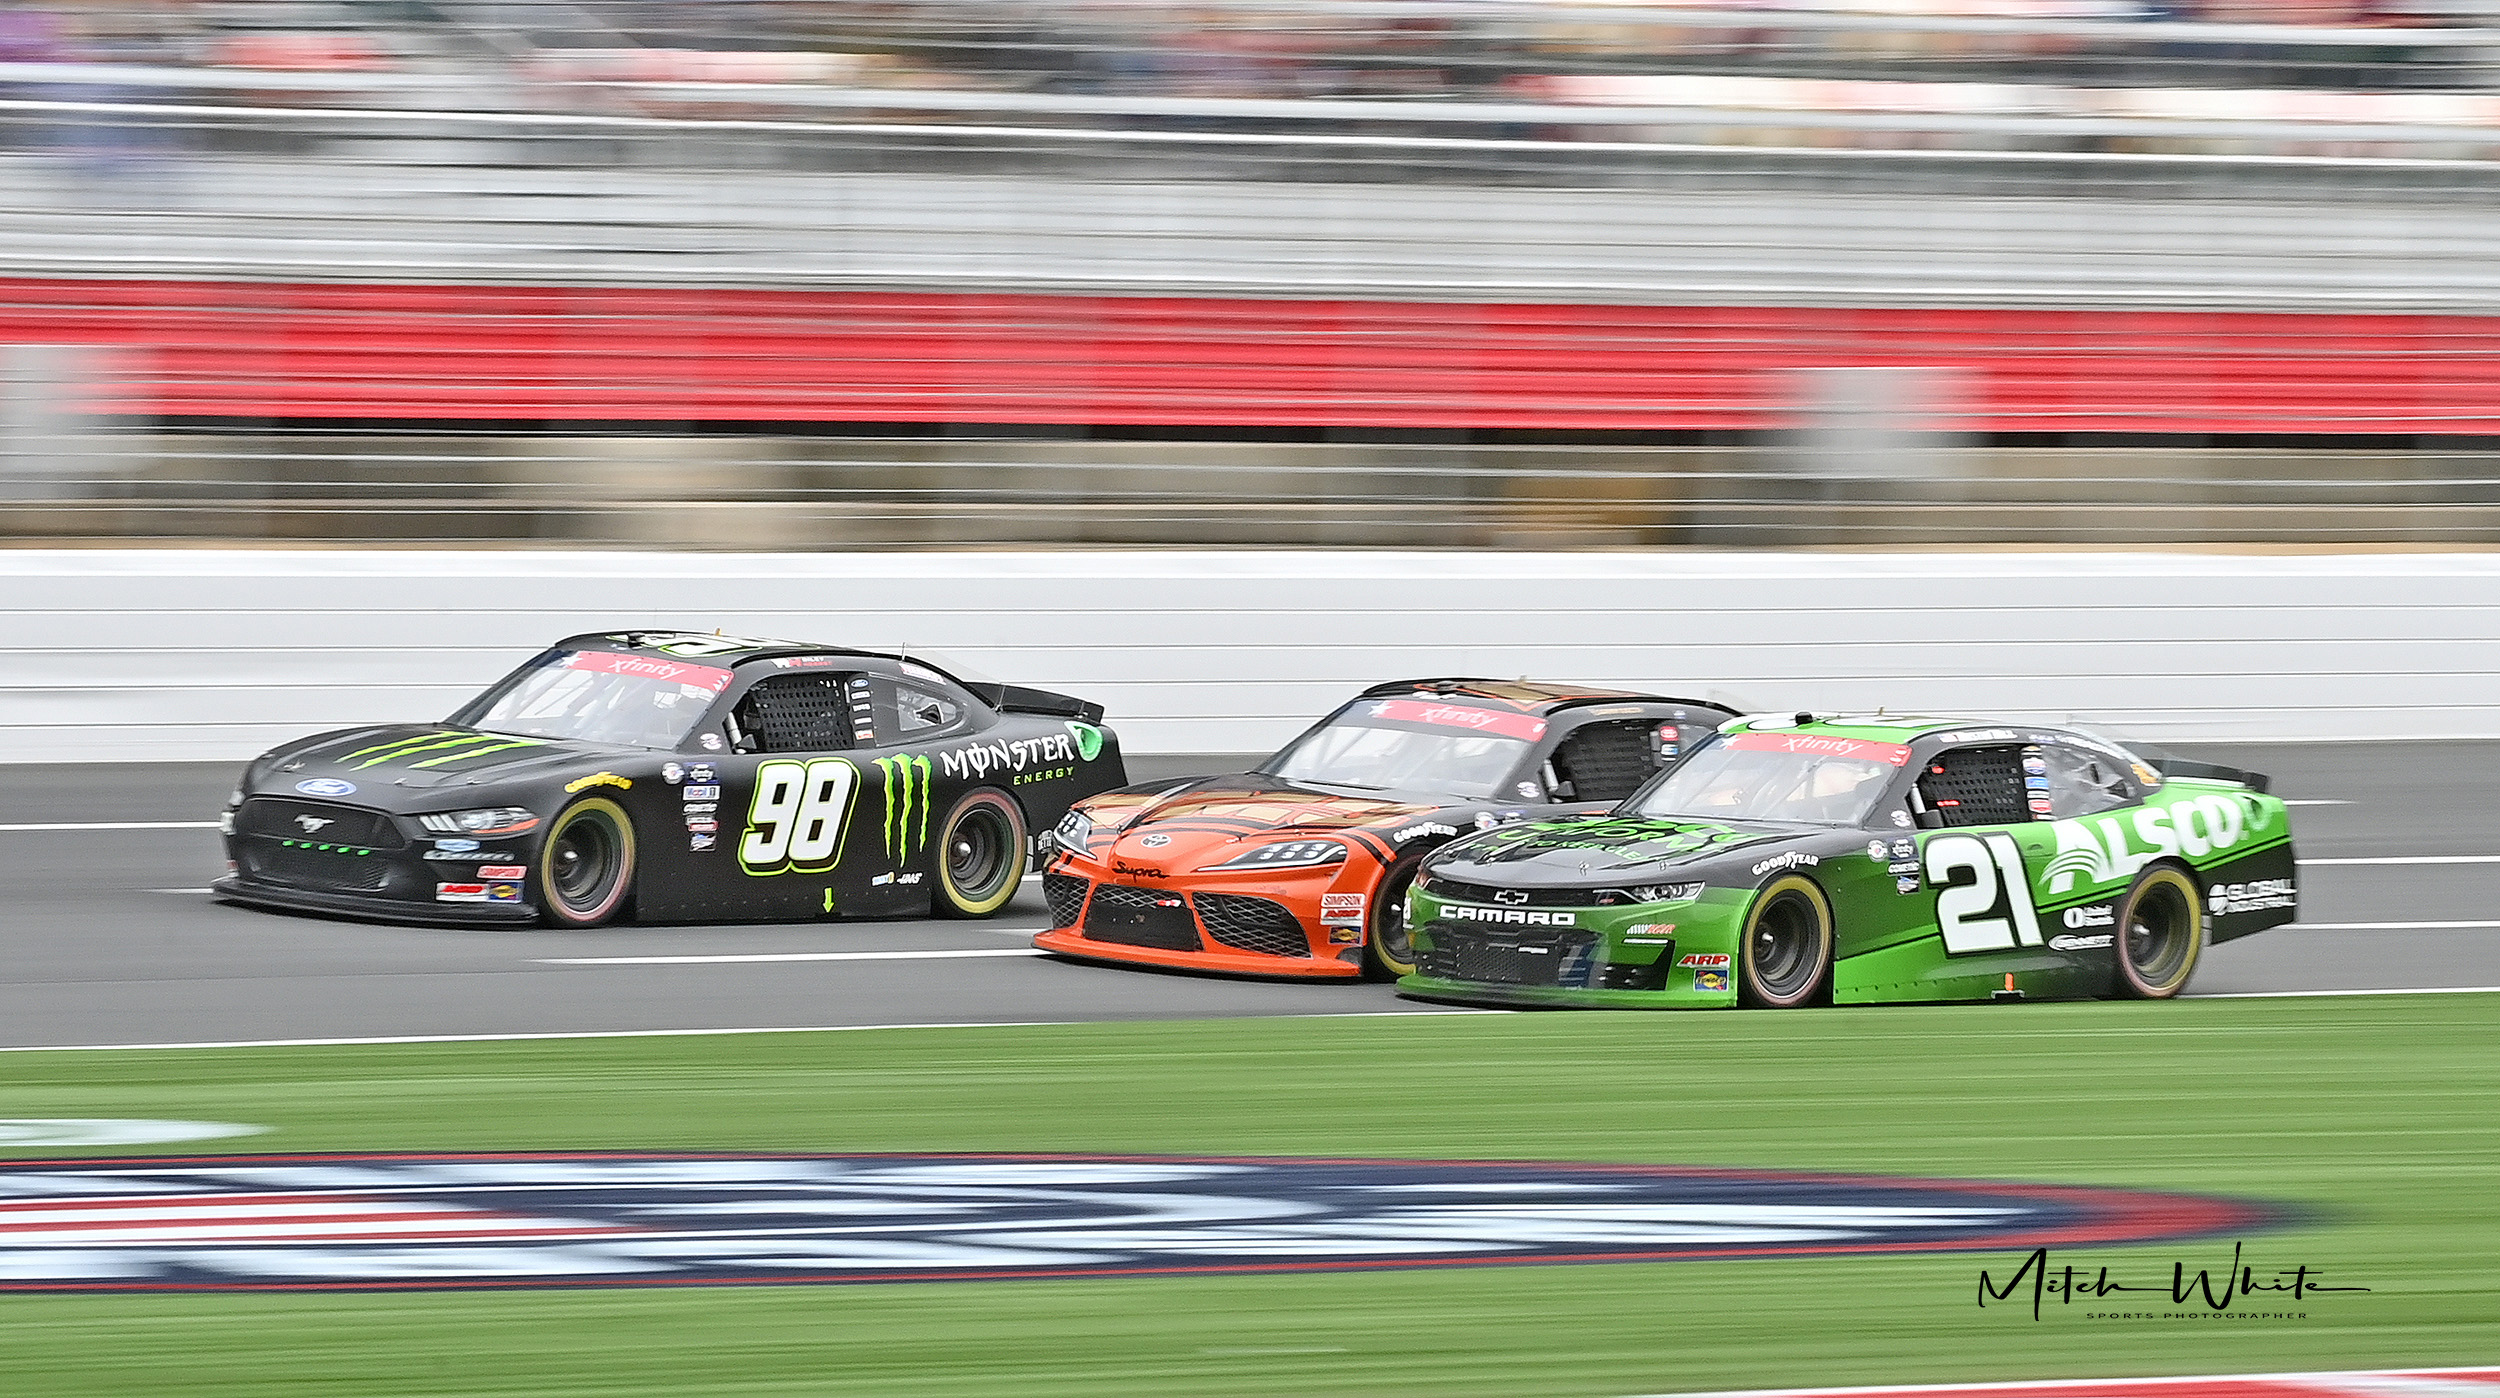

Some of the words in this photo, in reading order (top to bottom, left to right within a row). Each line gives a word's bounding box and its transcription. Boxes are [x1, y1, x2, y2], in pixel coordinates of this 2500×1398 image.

[608, 658, 686, 680] xfinity
[1418, 707, 1499, 728] xfinity
[1782, 736, 1863, 756] xfinity
[1013, 766, 1074, 786] ENERGY
[740, 762, 858, 870] 98
[2042, 795, 2243, 894] ALSCO
[1112, 861, 1170, 882] Supra
[1752, 851, 1819, 876] GOODYEAR
[1324, 895, 1361, 906] SIMPSON
[1925, 833, 2044, 951] 21
[1440, 905, 1575, 926] CAMARO
[1681, 955, 1729, 965] ARP
